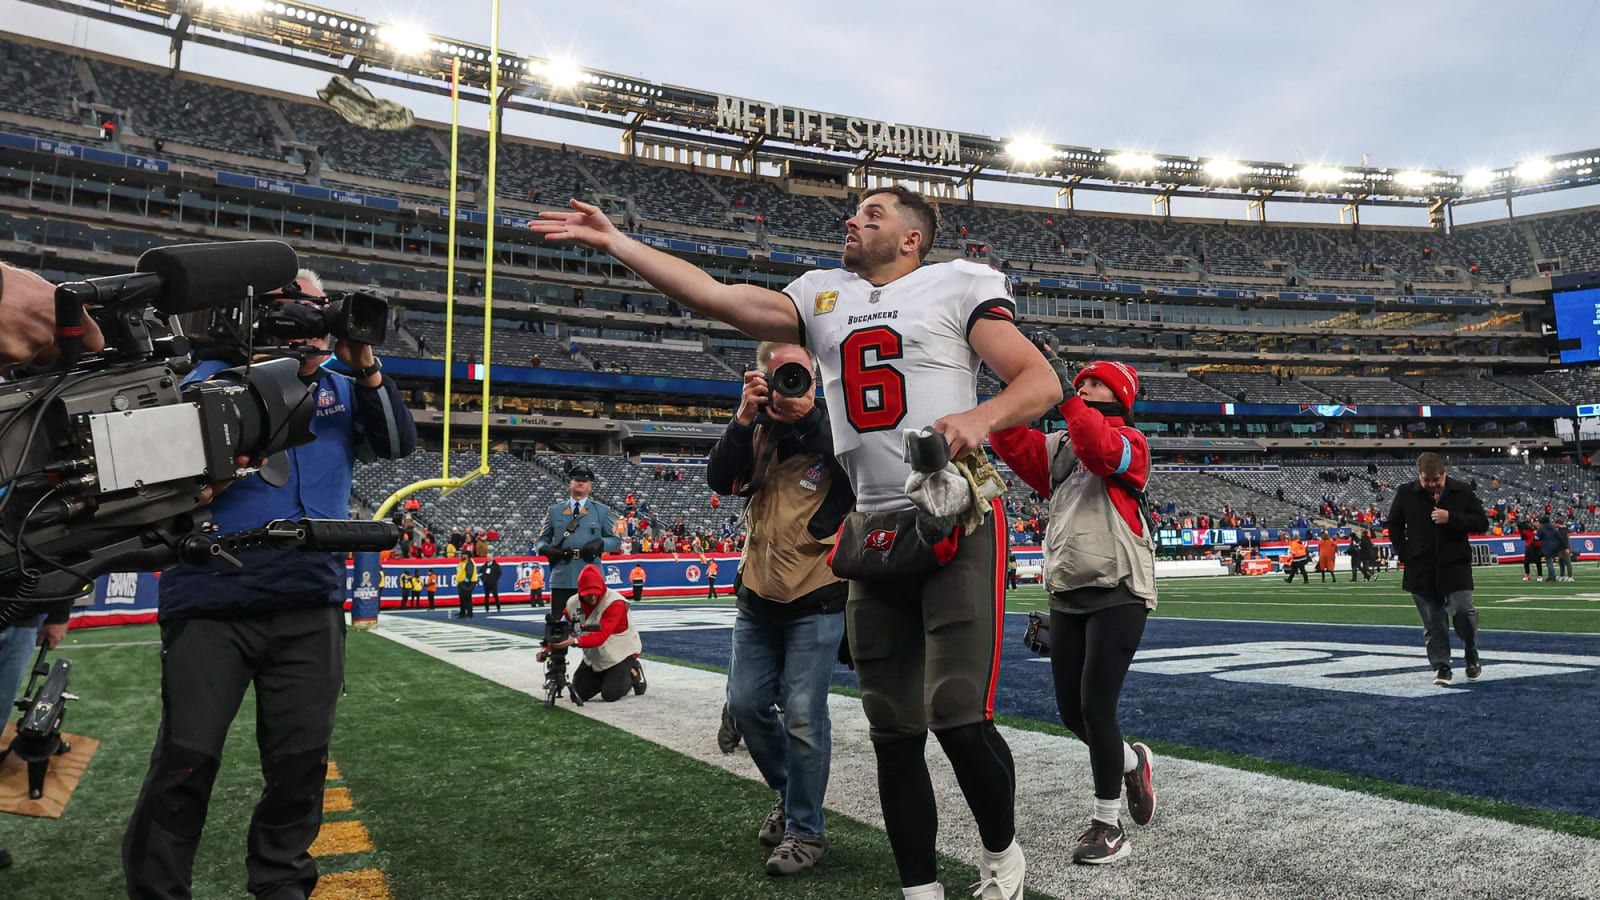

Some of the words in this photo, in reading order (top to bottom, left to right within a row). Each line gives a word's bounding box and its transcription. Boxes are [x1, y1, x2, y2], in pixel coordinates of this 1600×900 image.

[717, 95, 837, 145] METLIFE
[846, 117, 960, 162] STADIUM
[848, 310, 898, 325] BUCCANEERS
[840, 325, 907, 433] 6
[521, 417, 547, 425] MetLife
[662, 425, 702, 433] MetLife
[384, 575, 398, 589] RK
